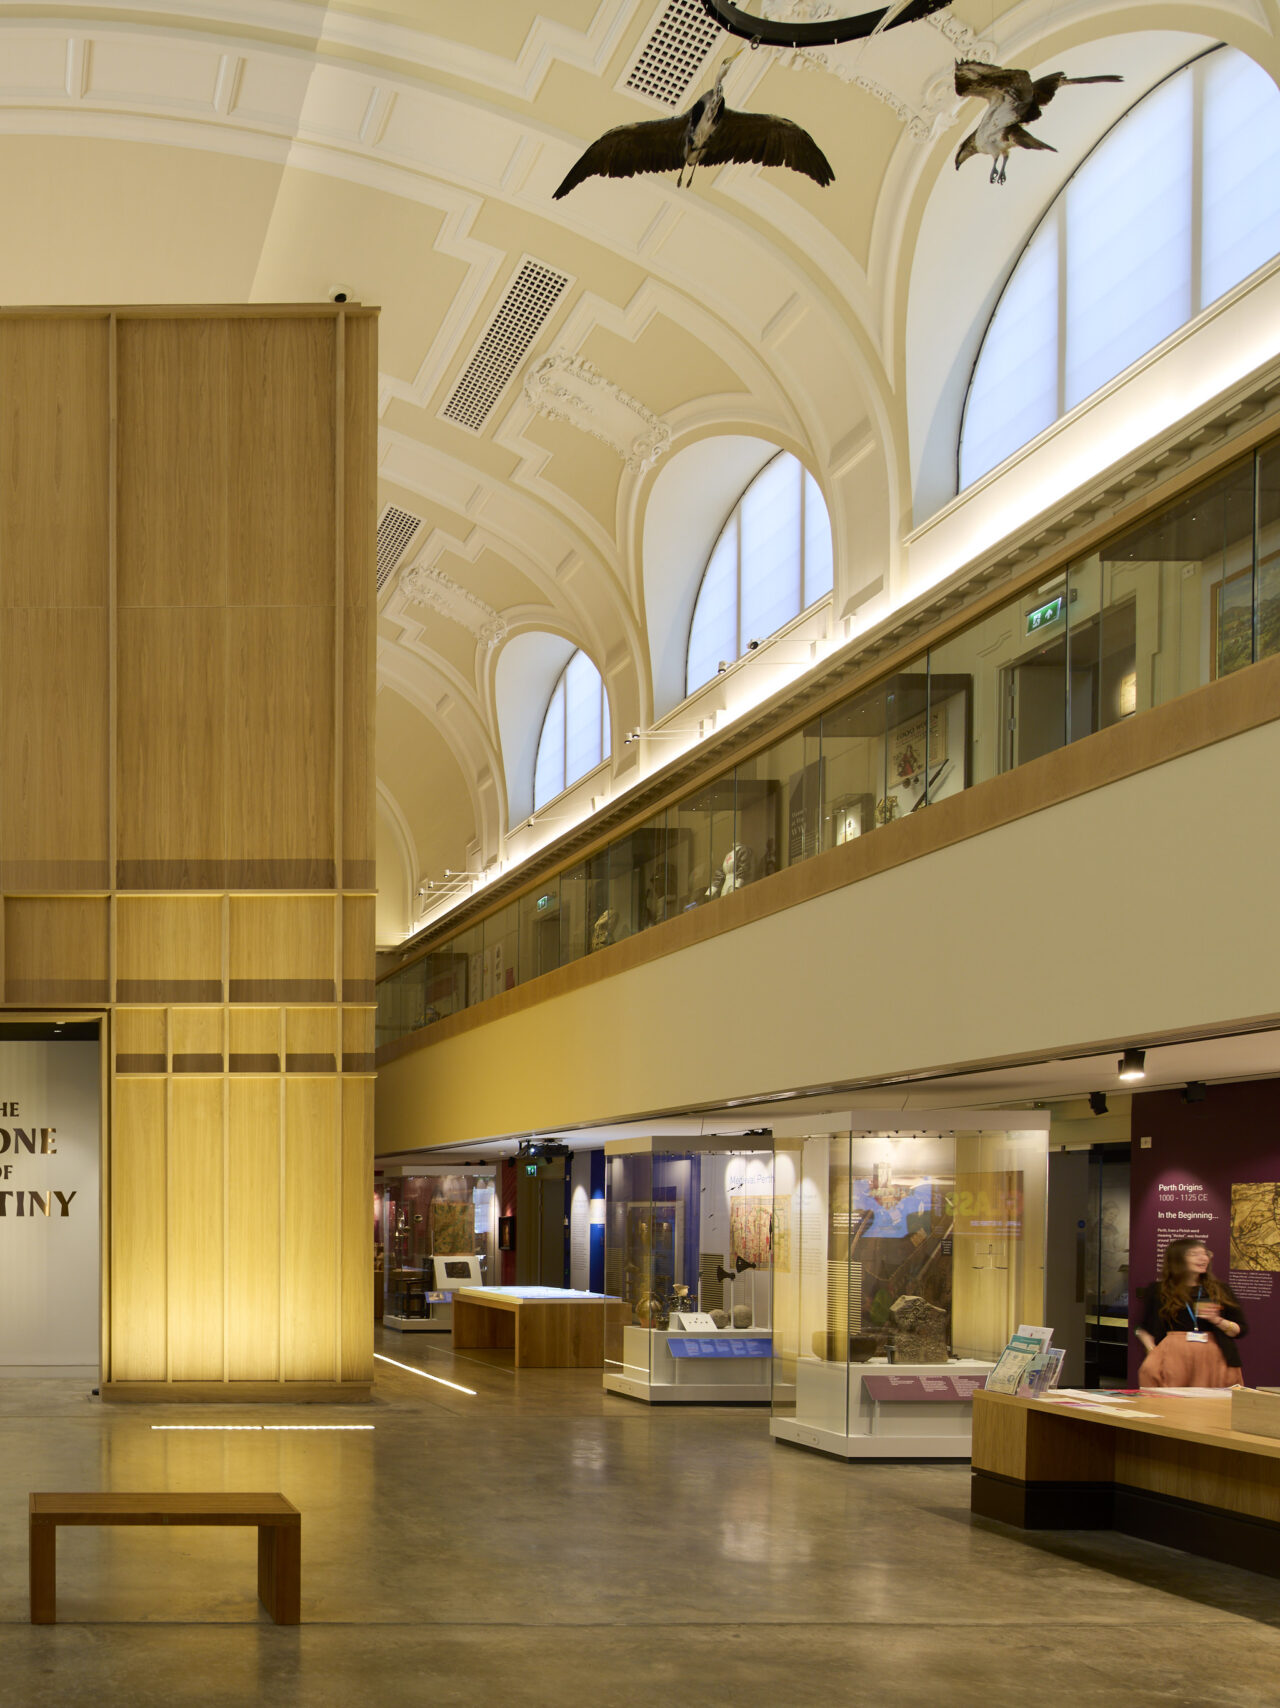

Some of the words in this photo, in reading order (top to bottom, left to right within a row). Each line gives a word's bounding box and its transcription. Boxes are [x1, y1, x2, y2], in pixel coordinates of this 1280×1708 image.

[729, 1175, 756, 1185] Medieval
[1178, 1184, 1203, 1192] Origins
[1178, 1211, 1219, 1220] Beginning...
